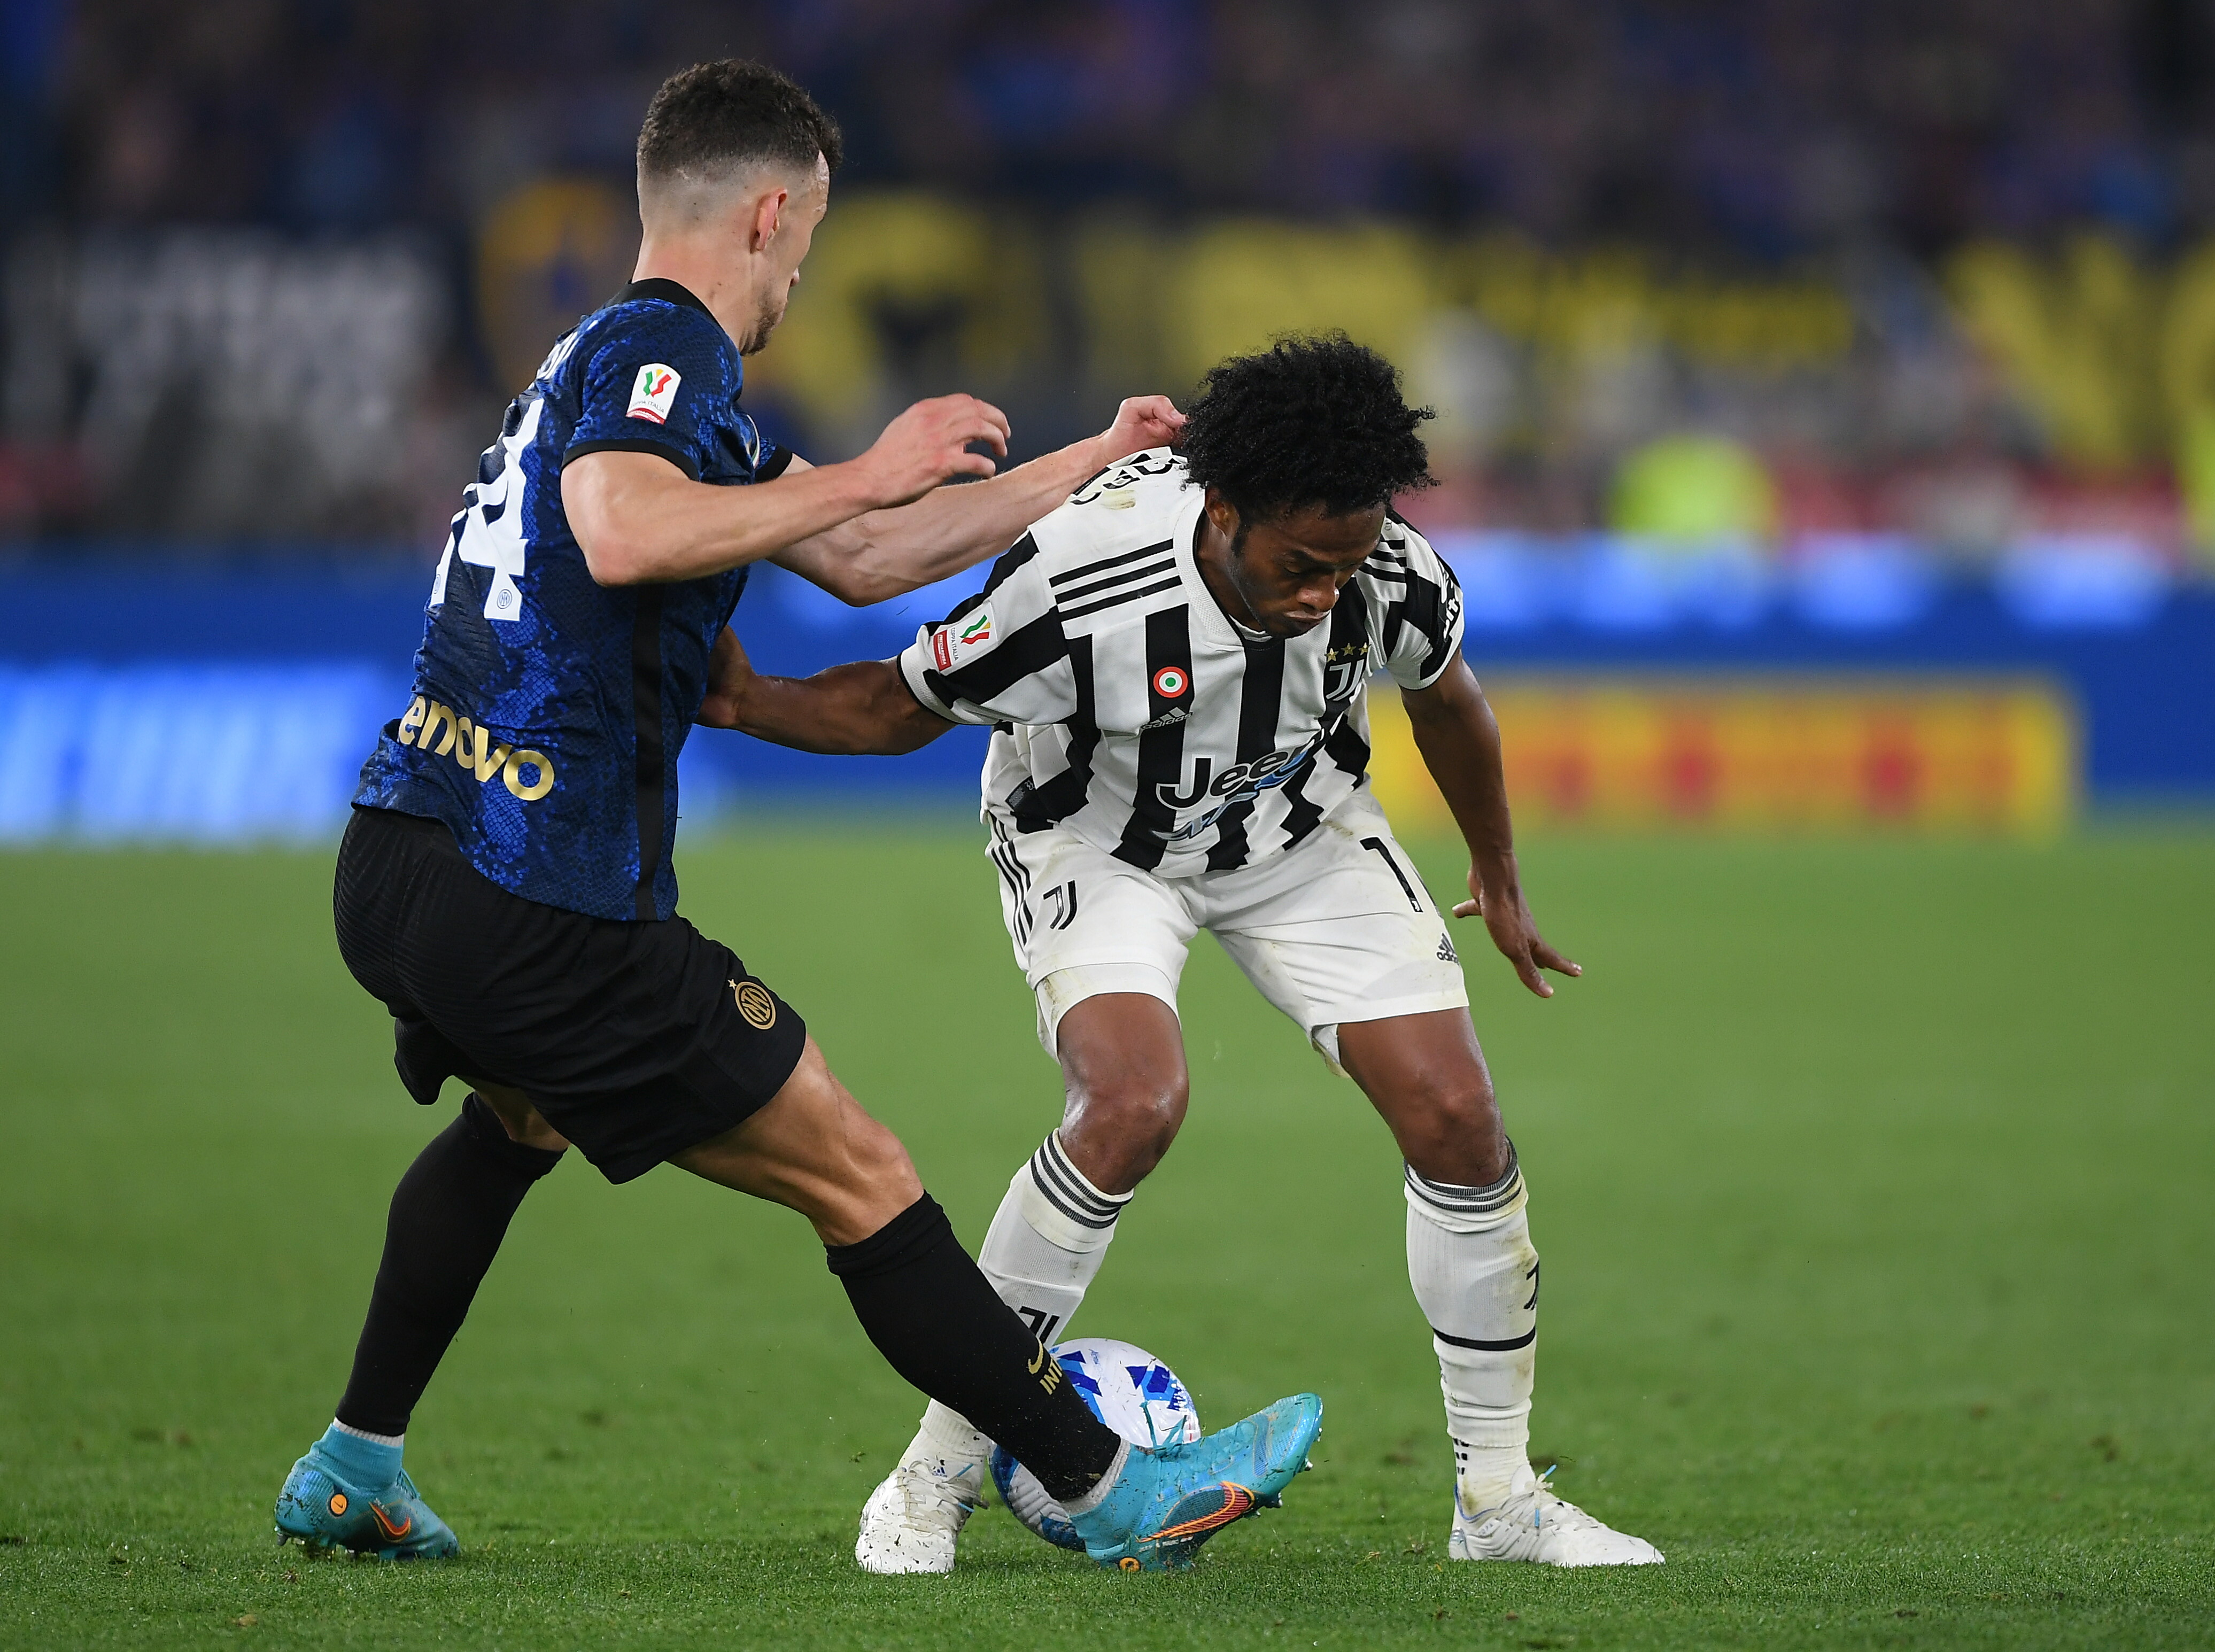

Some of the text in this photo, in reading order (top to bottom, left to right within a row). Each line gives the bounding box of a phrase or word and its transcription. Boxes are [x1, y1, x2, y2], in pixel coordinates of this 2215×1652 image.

[647, 401, 664, 413] ITALIA
[398, 695, 555, 801] enovo
[1156, 739, 1315, 810] Jee
[1359, 836, 1424, 913] 1
[1040, 1355, 1063, 1395] INT
